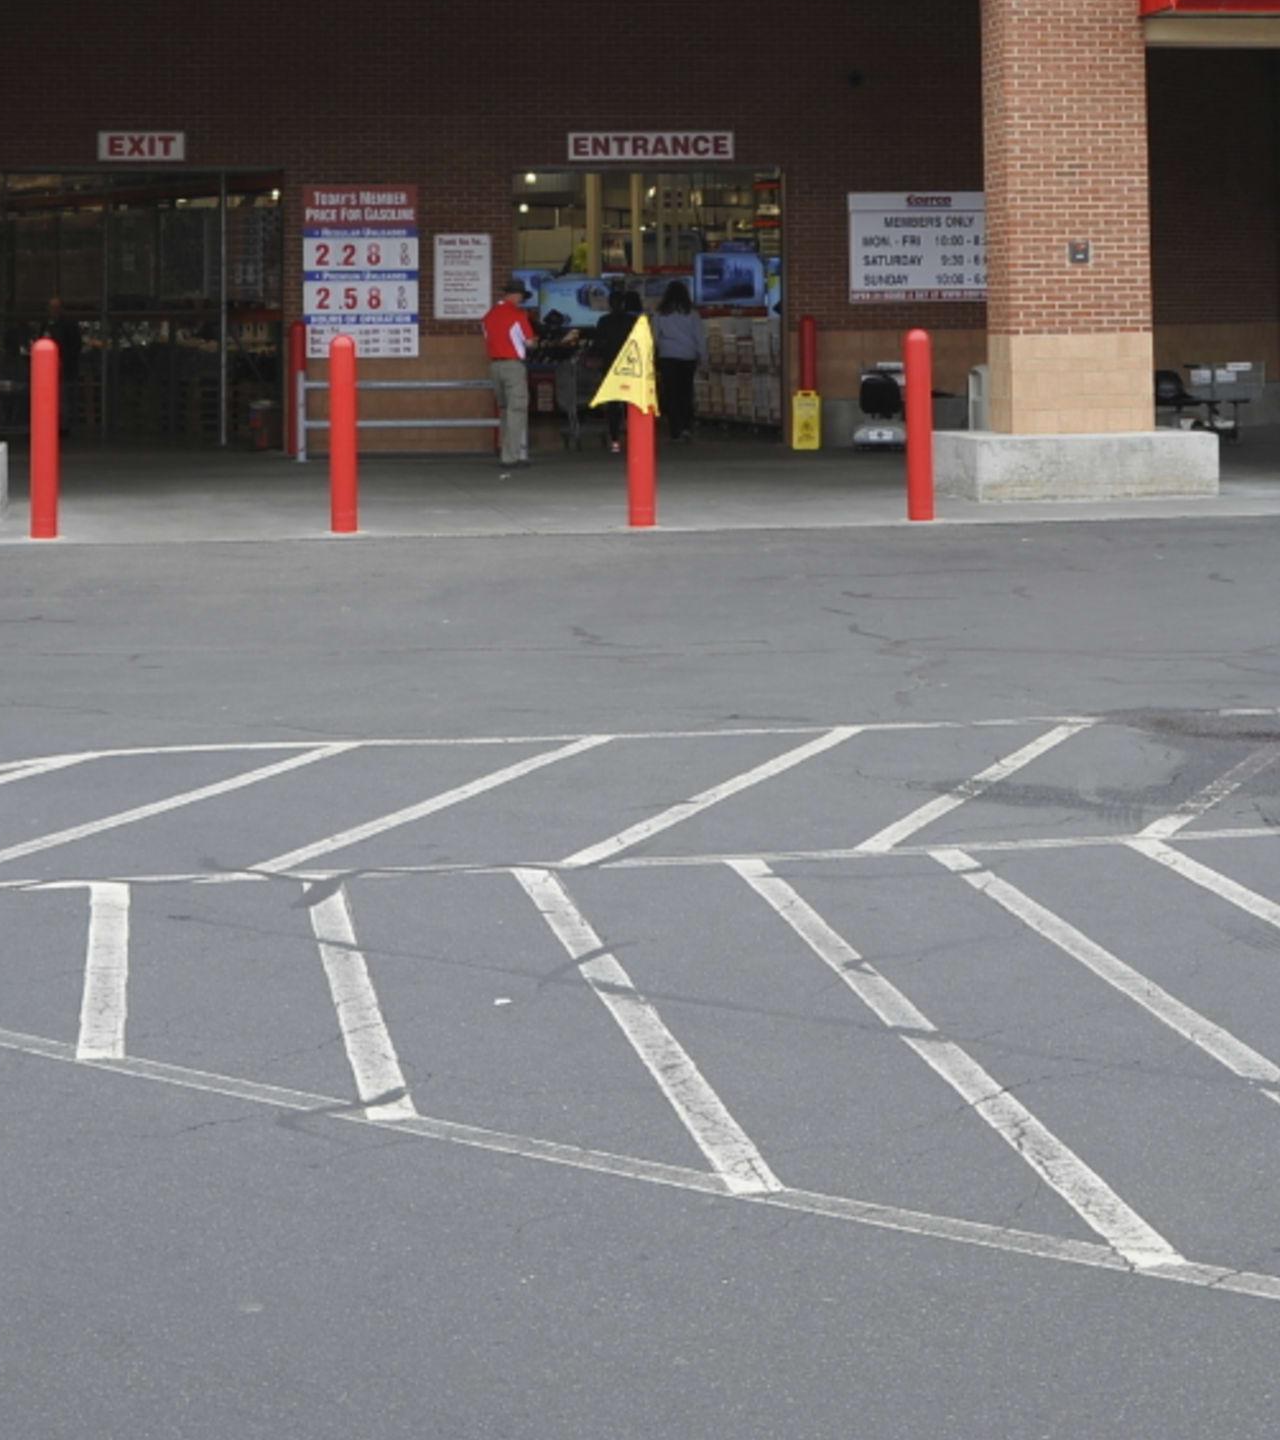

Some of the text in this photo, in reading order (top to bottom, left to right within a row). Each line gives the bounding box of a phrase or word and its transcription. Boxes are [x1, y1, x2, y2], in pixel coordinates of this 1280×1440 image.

[108, 135, 177, 157] EXIT
[573, 135, 729, 156] ENTRANCE
[359, 191, 408, 205] MEMBER
[305, 207, 415, 222] PRICE FOR GASOLINE
[884, 216, 975, 228] MEMBERS ONLY
[863, 255, 923, 266] SATURDAY
[864, 273, 909, 286] SUNDAY
